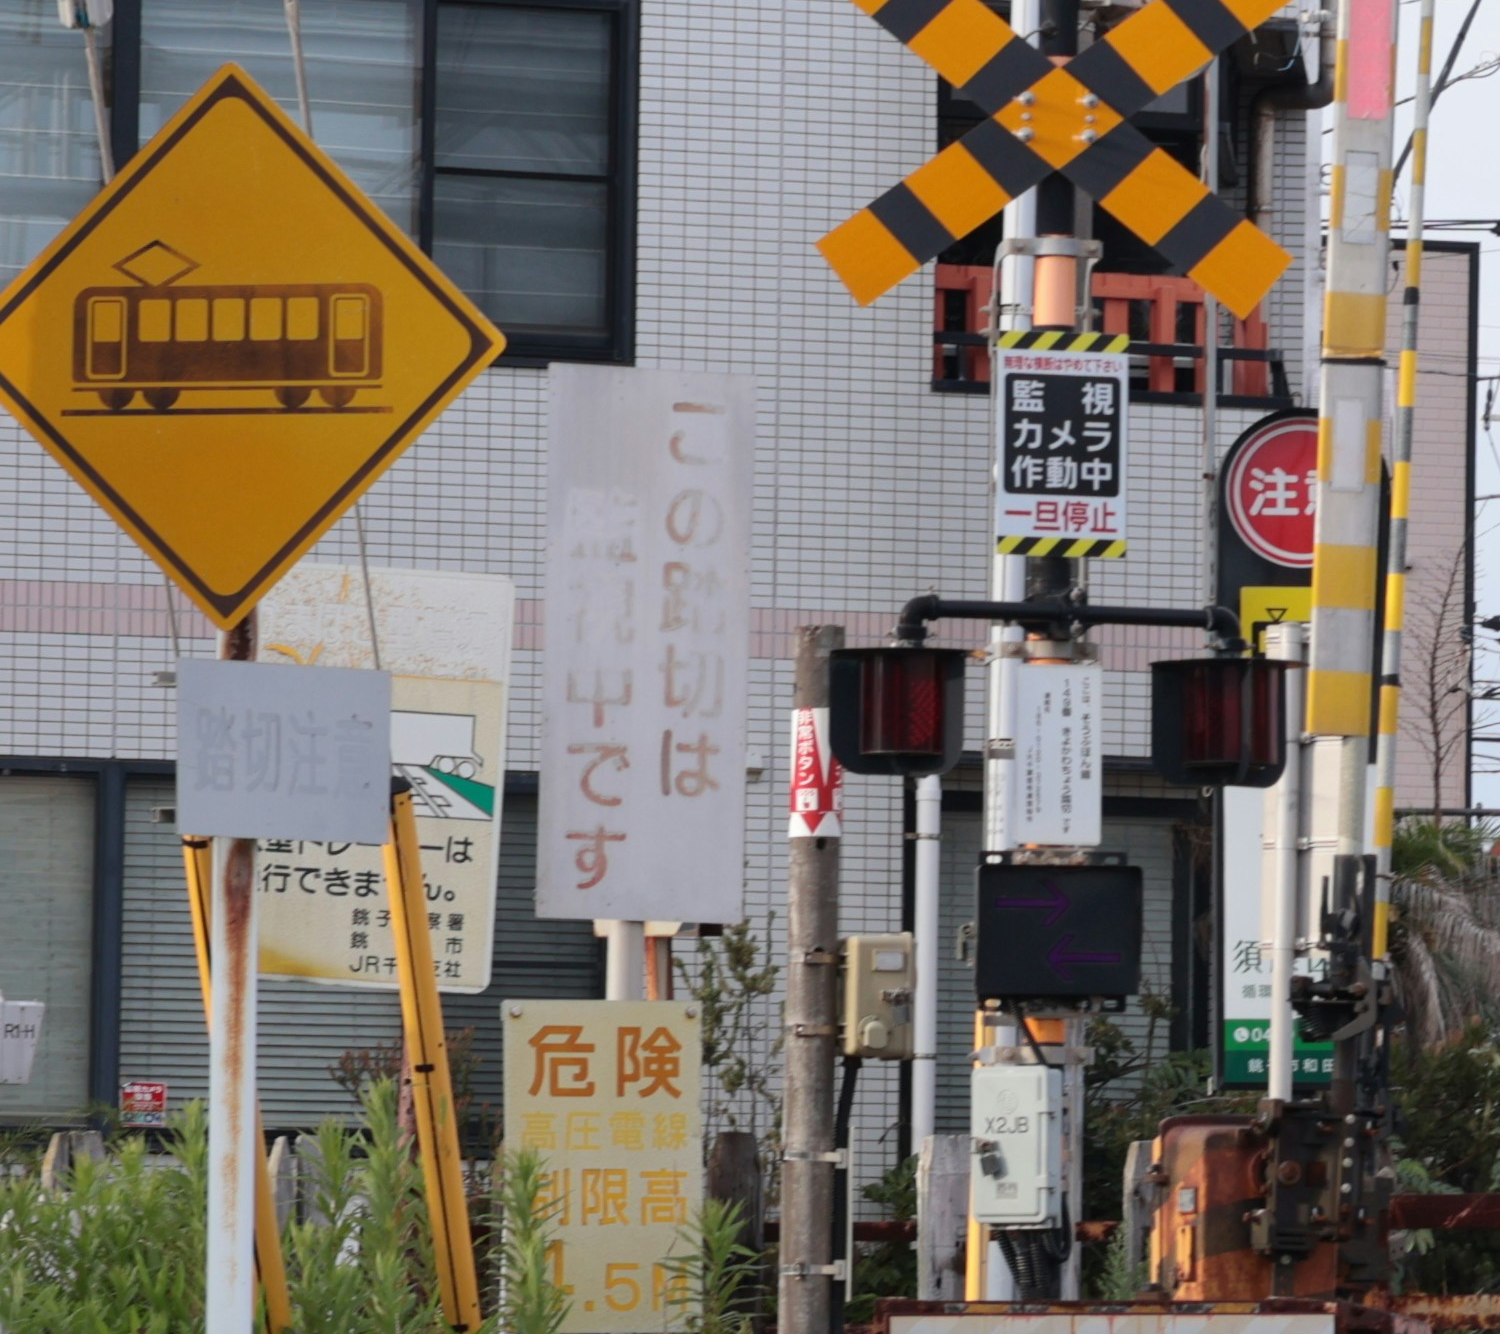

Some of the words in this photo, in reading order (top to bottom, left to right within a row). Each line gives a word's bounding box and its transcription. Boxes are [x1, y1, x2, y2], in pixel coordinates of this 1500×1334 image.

[1012, 380, 1114, 415] 監視
[1013, 418, 1112, 452] カメラ
[1011, 455, 1113, 491] 作動中
[1249, 467, 1317, 516] 注
[1005, 501, 1117, 533] 一旦停止
[194, 705, 376, 799] 踏切注意
[352, 908, 465, 931] 銚子察署
[527, 1025, 683, 1100] 危険
[520, 1110, 689, 1152] 高圧電線
[984, 1116, 1030, 1134] X2JB
